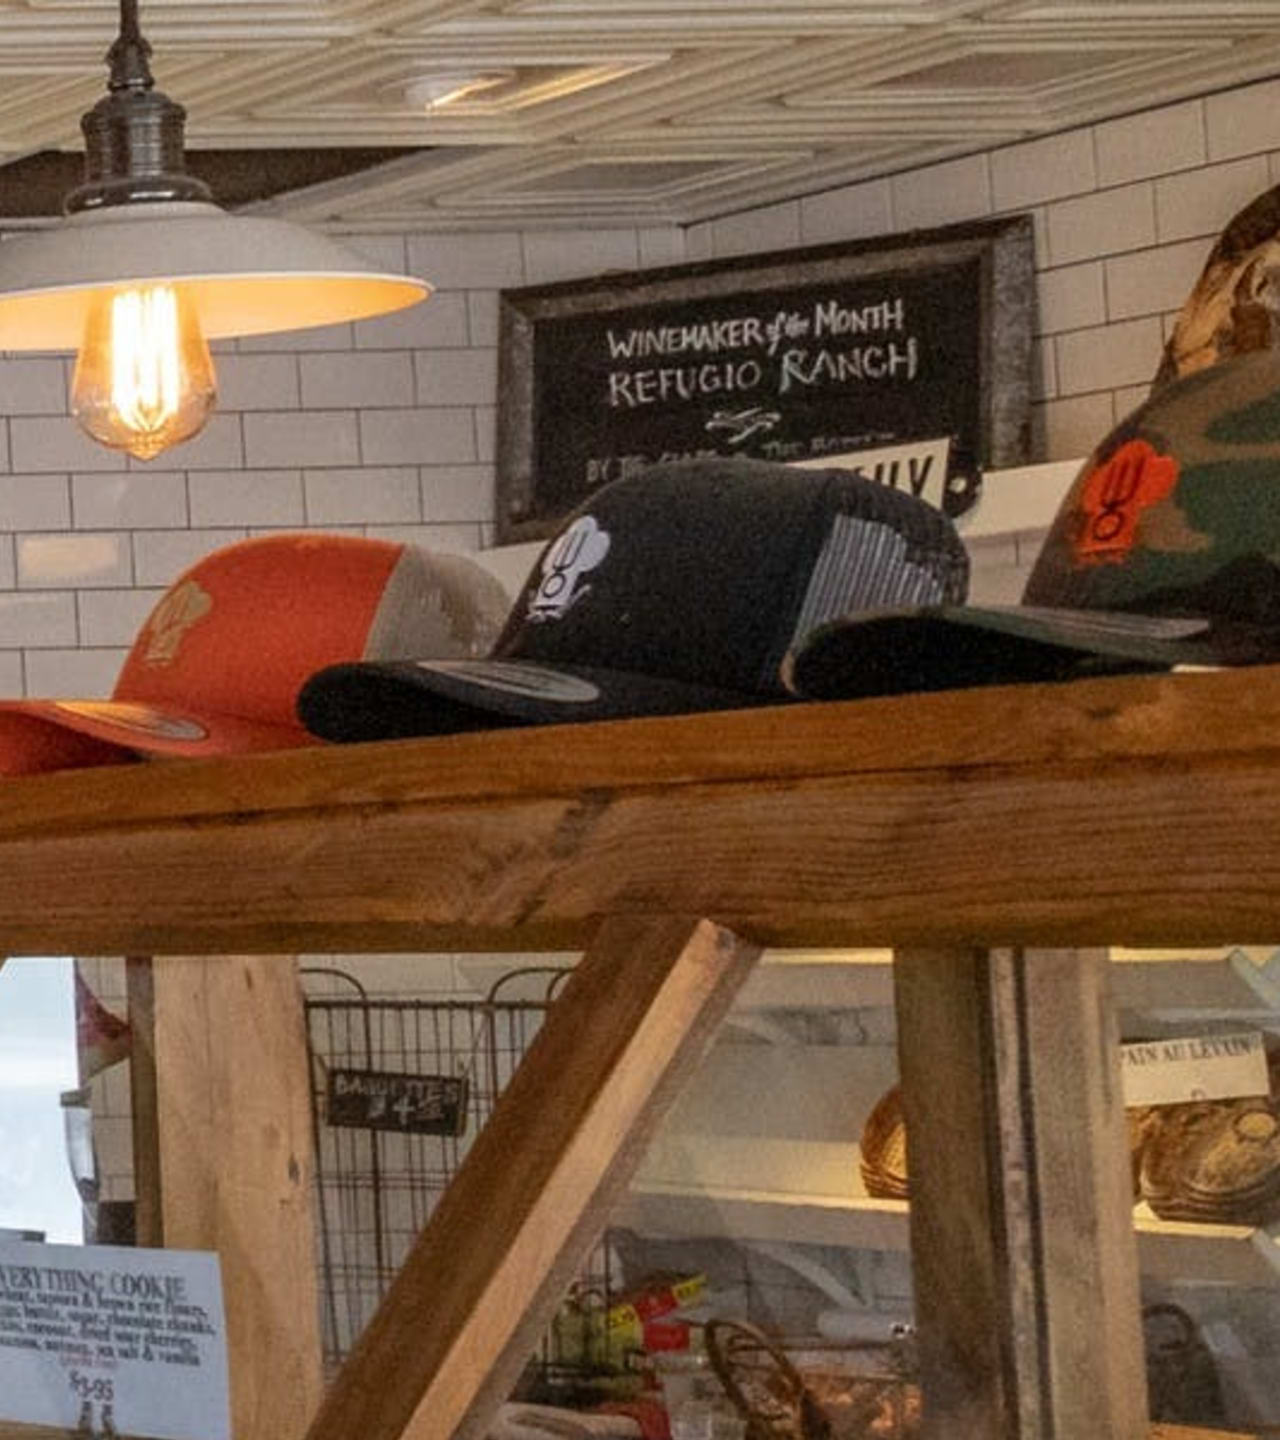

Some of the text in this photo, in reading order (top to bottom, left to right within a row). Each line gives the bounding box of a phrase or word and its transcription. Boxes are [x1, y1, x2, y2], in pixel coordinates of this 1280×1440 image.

[606, 317, 764, 358] WINEMAKER
[814, 299, 903, 337] MONTH
[608, 336, 917, 407] REFUGIO RANCH
[110, 1270, 189, 1302] COOKIE
